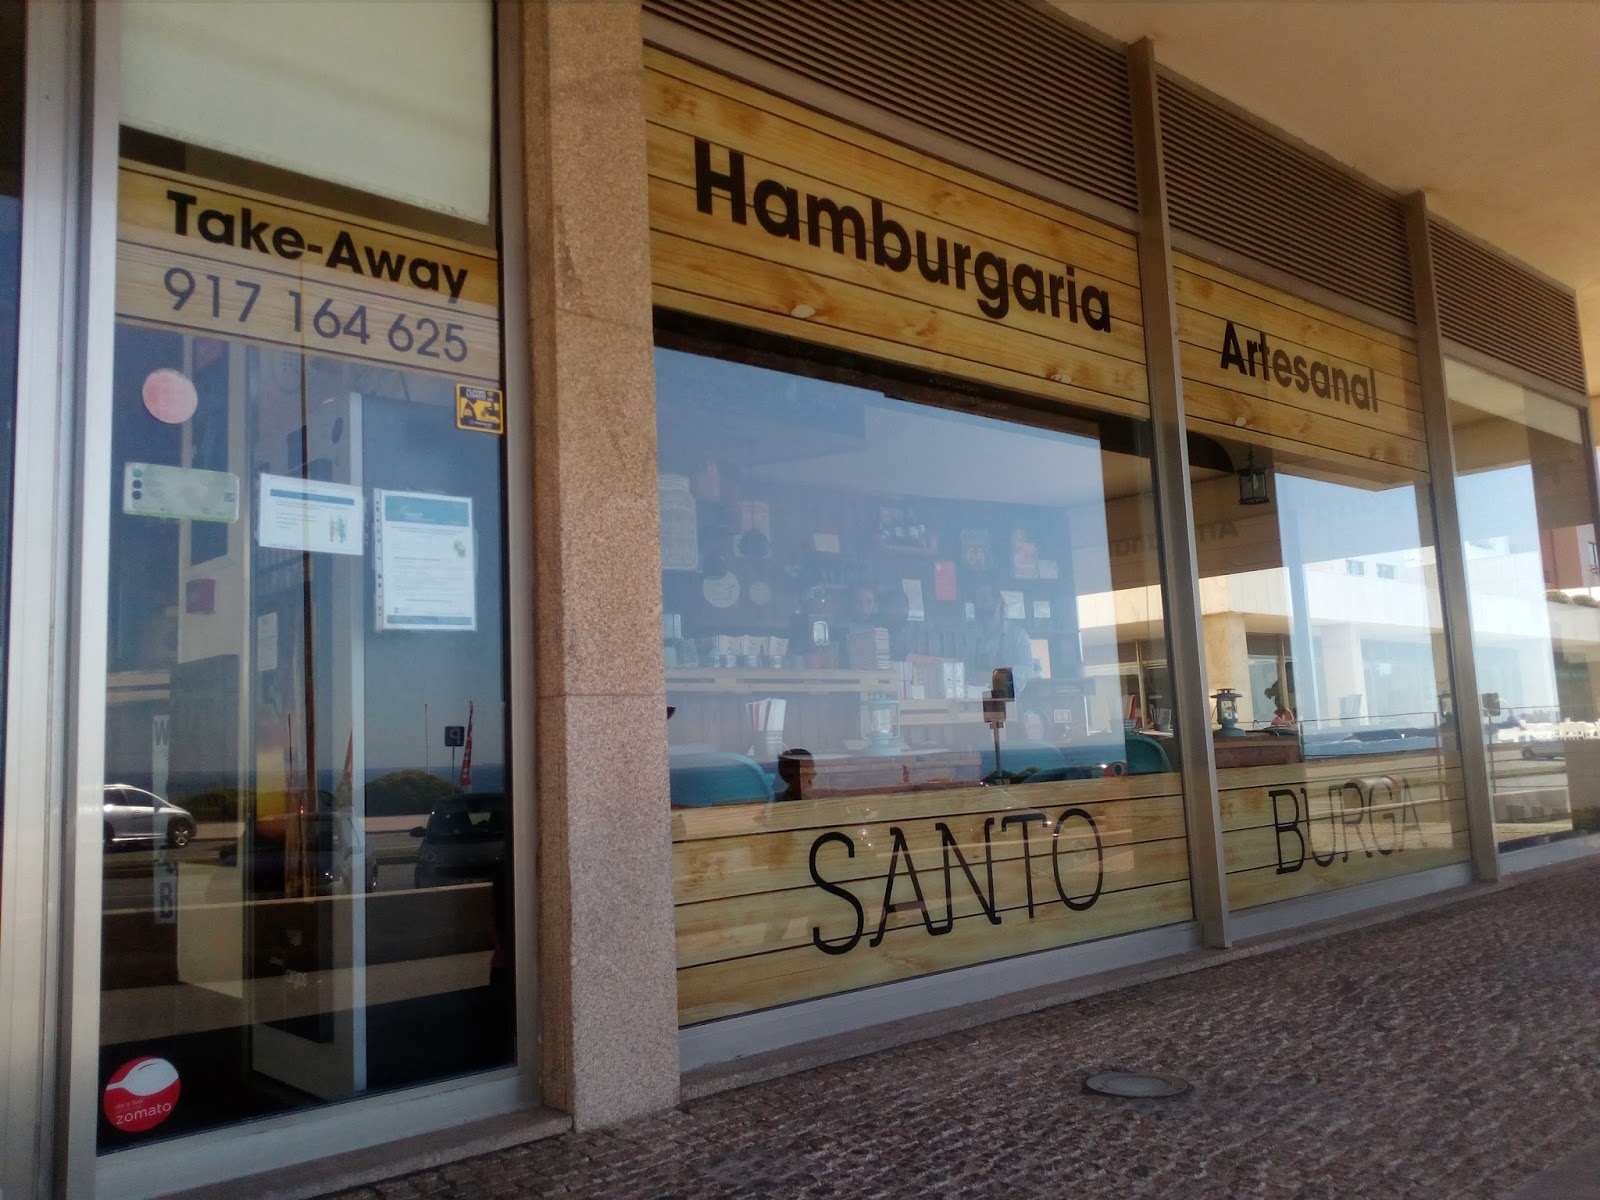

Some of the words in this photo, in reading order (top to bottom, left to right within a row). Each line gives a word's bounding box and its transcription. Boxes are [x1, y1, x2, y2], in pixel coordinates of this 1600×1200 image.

[167, 190, 468, 304] Take-Away
[694, 137, 1112, 333] Hamburgaria
[1220, 321, 1378, 412] Artesanal
[164, 267, 261, 322] 917
[288, 290, 370, 344] 164
[388, 314, 468, 362] 625
[809, 808, 1103, 955] SANTO
[1269, 776, 1428, 875] BURGA
[116, 1103, 171, 1124] zomato
